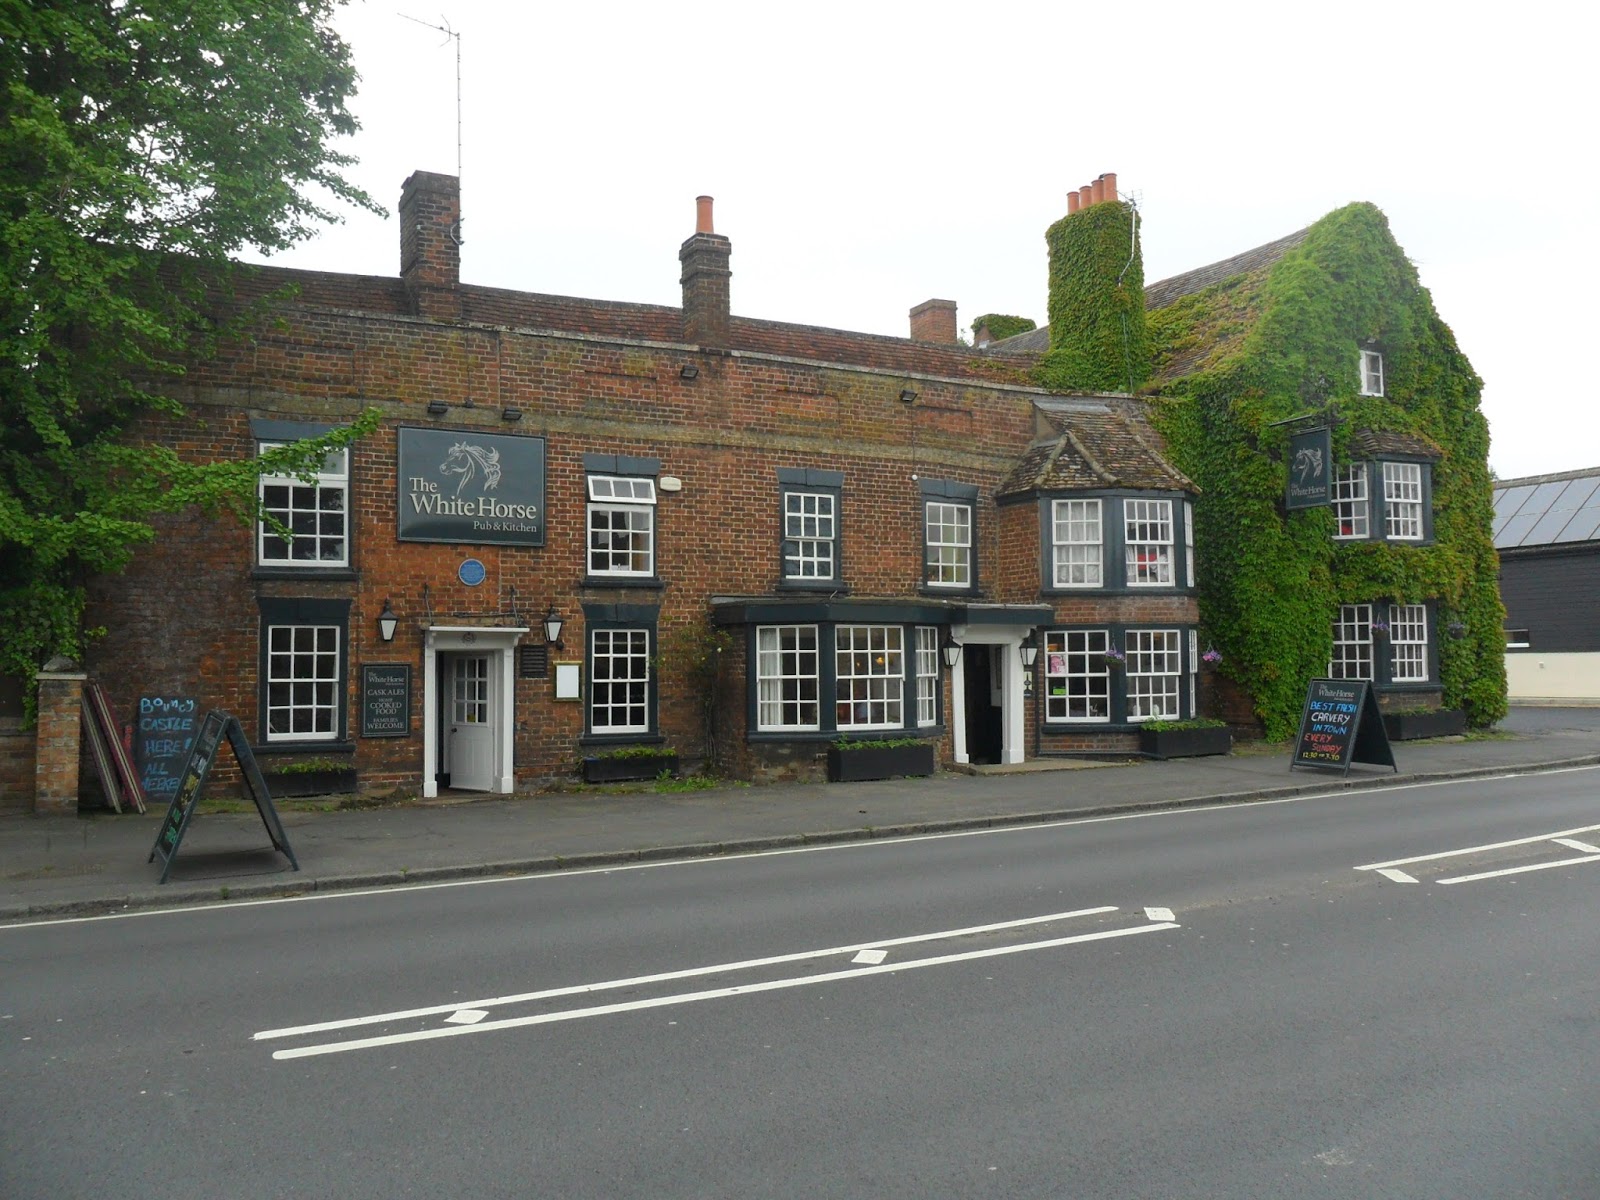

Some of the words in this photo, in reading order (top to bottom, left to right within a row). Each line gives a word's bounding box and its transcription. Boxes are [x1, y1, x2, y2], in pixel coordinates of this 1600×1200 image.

[409, 477, 438, 492] The
[409, 493, 475, 516] White
[477, 496, 537, 519] Horse
[473, 520, 492, 530] Pub
[493, 522, 501, 531] &
[502, 522, 537, 533] Kitchen
[1318, 688, 1336, 697] White
[1335, 689, 1355, 698] Horse
[1310, 701, 1334, 711] BEST
[1335, 703, 1358, 713] FRESH
[141, 717, 193, 731] CASTLE
[1311, 712, 1350, 725] CARVERY
[1312, 723, 1323, 732] IN
[1323, 725, 1347, 735] TOWN
[1304, 733, 1333, 743] EVERY
[1312, 743, 1341, 754] SUNDAY
[145, 762, 169, 775] ALL
